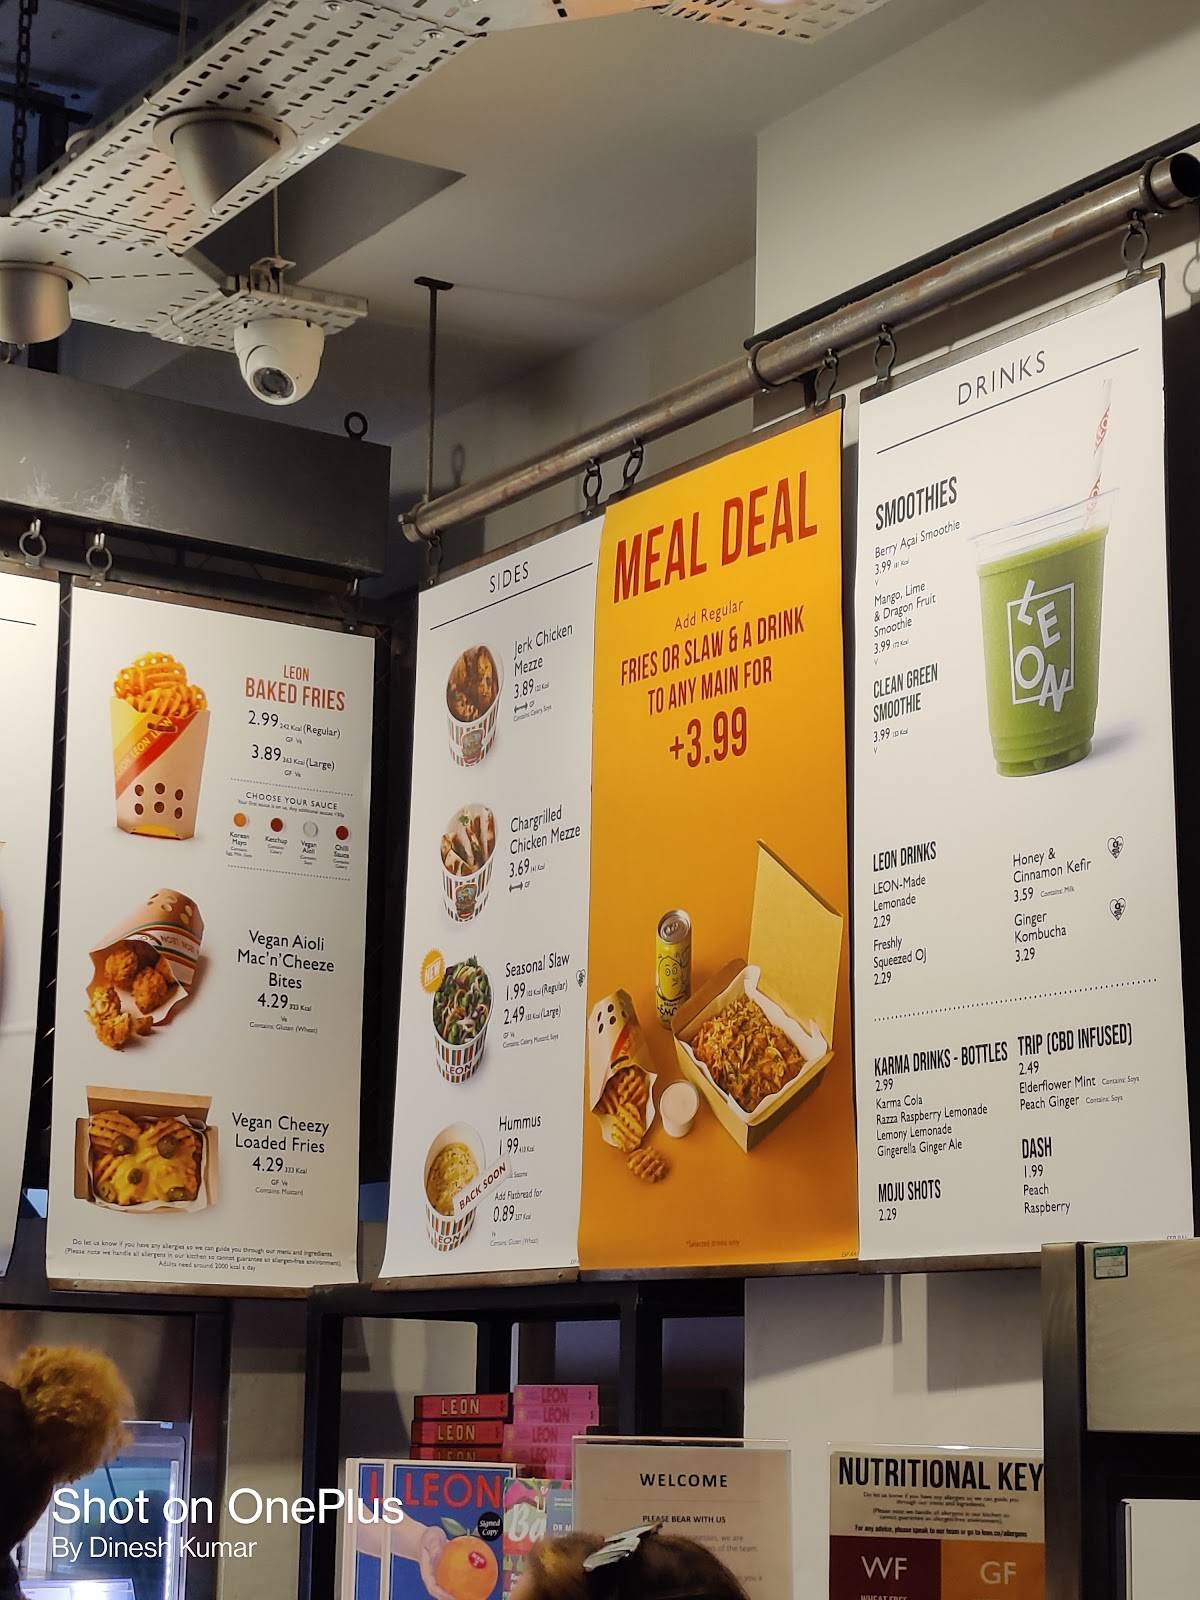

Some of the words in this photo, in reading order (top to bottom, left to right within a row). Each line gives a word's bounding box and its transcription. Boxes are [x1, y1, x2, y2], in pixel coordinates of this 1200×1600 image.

[958, 351, 1046, 405] DRINKS
[876, 476, 957, 530] SMOOTHIES
[613, 512, 707, 603] MEAL
[722, 471, 817, 565] DEAL
[875, 544, 898, 558] Berry
[921, 520, 960, 542] Smoothie
[489, 561, 529, 592] SIDES
[875, 560, 891, 575] 3.99
[875, 592, 902, 607] Mango,
[906, 583, 925, 596] Lime
[674, 611, 696, 632] Add
[702, 600, 744, 625] Regular
[874, 611, 880, 622] &
[883, 602, 913, 619] Dragon
[917, 593, 936, 609] Fruit
[874, 618, 912, 637] Smoothie
[514, 636, 532, 660] Jerk
[536, 624, 572, 647] Chicken
[621, 651, 657, 686] FRIES
[663, 643, 679, 672] OR
[684, 629, 723, 664] SLAW
[729, 626, 737, 652] &
[743, 622, 751, 648] A
[757, 605, 804, 645] DRINK
[874, 640, 890, 654] 3.99
[284, 664, 309, 681] LEON
[515, 656, 543, 677] Mezze
[514, 679, 534, 699] 3.89
[648, 689, 663, 715] TO
[669, 678, 697, 710] ANY
[701, 665, 738, 700] MAIN
[744, 656, 772, 689] FOR
[874, 673, 903, 698] CLEAN
[907, 663, 938, 688] GREEN
[246, 677, 297, 704] BAKED
[302, 686, 345, 711] FRIES
[874, 693, 921, 722] SMOOTHIE
[248, 711, 278, 727] 2.99
[303, 724, 340, 739] (Regular)
[670, 706, 747, 767] +3.99
[874, 728, 890, 743] 3.99
[252, 744, 281, 761] 3.89
[306, 758, 334, 771] (Large)
[246, 792, 281, 802] CHOOSE
[285, 798, 308, 806] YOUR
[311, 801, 338, 810] SAUCE
[511, 804, 562, 833] Chargrilled
[510, 833, 547, 855] Chicken
[551, 825, 580, 845] Mezze
[874, 850, 897, 872] LEON
[901, 841, 936, 866] DRINKS
[1013, 852, 1044, 866] Honey
[1048, 848, 1055, 859] &
[509, 858, 530, 878] 3.69
[1014, 866, 1062, 883] Cinnamon
[1067, 858, 1091, 874] Kefir
[874, 874, 926, 895] LEON-Made
[874, 893, 916, 911] Lemonade
[1014, 887, 1033, 902] 3.59
[874, 915, 890, 928] 2.29
[1015, 913, 1047, 927] Ginger
[249, 930, 288, 949] Vegan
[292, 935, 324, 951] Aioli
[874, 936, 902, 951] Freshly
[1015, 925, 1066, 944] Kombucha
[874, 951, 912, 970] Squeezed
[916, 948, 926, 963] OJ
[1015, 948, 1035, 962] 3.29
[505, 955, 546, 978] Seasonal
[549, 952, 570, 968] Slaw
[269, 972, 302, 988] Bites
[874, 971, 891, 985] 2.29
[506, 982, 525, 1000] 1.99
[542, 980, 568, 997] (Regular)
[257, 993, 288, 1009] 4.29
[504, 1006, 525, 1025] 2.49
[541, 1005, 561, 1021] (Large)
[1018, 1034, 1042, 1056] TRIP
[1047, 1030, 1073, 1055] (CBD
[1078, 1023, 1132, 1048] INFUSED)
[875, 1055, 910, 1076] KARMA
[914, 1049, 950, 1072] DRINKS
[961, 1041, 1007, 1066] BOTTLES
[1019, 1061, 1039, 1075] 2.49
[445, 1062, 471, 1075] LEON
[876, 1079, 893, 1091] 2.99
[1020, 1079, 1071, 1093] Elderflower
[1075, 1076, 1096, 1088] Mint
[876, 1097, 901, 1109] Karma
[904, 1094, 922, 1106] Cola
[1020, 1098, 1045, 1110] Peach
[1049, 1095, 1079, 1109] Ginger
[499, 1115, 541, 1132] Hummus
[877, 1115, 897, 1125] Razza
[901, 1110, 941, 1124] Raspberry
[945, 1104, 987, 1118] Lemonade
[232, 1112, 272, 1131] Vegan
[278, 1116, 329, 1137] Cheezy
[877, 1129, 907, 1141] Lemony
[910, 1124, 951, 1137] Lemonade
[235, 1134, 286, 1150] Loaded
[292, 1137, 325, 1153] Fries
[878, 1143, 916, 1158] Gingerella
[920, 1142, 946, 1155] Ginger
[949, 1139, 962, 1150] Ale
[1022, 1137, 1051, 1159] DASH
[252, 1157, 283, 1171] 4.29
[1024, 1164, 1043, 1178] 1.99
[459, 1185, 481, 1211] BACK
[483, 1162, 506, 1190] SOON
[879, 1182, 904, 1203] MOJU
[908, 1180, 940, 1200] SHOTS
[1024, 1184, 1049, 1196] Peach
[494, 1205, 515, 1222] 0.89
[879, 1208, 896, 1221] 2.29
[1024, 1202, 1070, 1216] Raspberry
[125, 1242, 135, 1250] you
[541, 1388, 568, 1403] LEON
[441, 1399, 479, 1415] LEON
[544, 1407, 569, 1423] LEON
[438, 1425, 475, 1440] LEON
[640, 1473, 728, 1487] WELCOME
[839, 1457, 990, 1490] NUTRITIONAL
[998, 1462, 1044, 1491] KEY
[404, 1472, 500, 1509] LEON
[479, 1519, 500, 1529] Signed
[642, 1515, 669, 1523] PLEASE
[482, 1528, 498, 1536] Copy
[865, 1526, 874, 1534] any
[861, 1556, 907, 1580] WF
[981, 1561, 1016, 1584] GF
